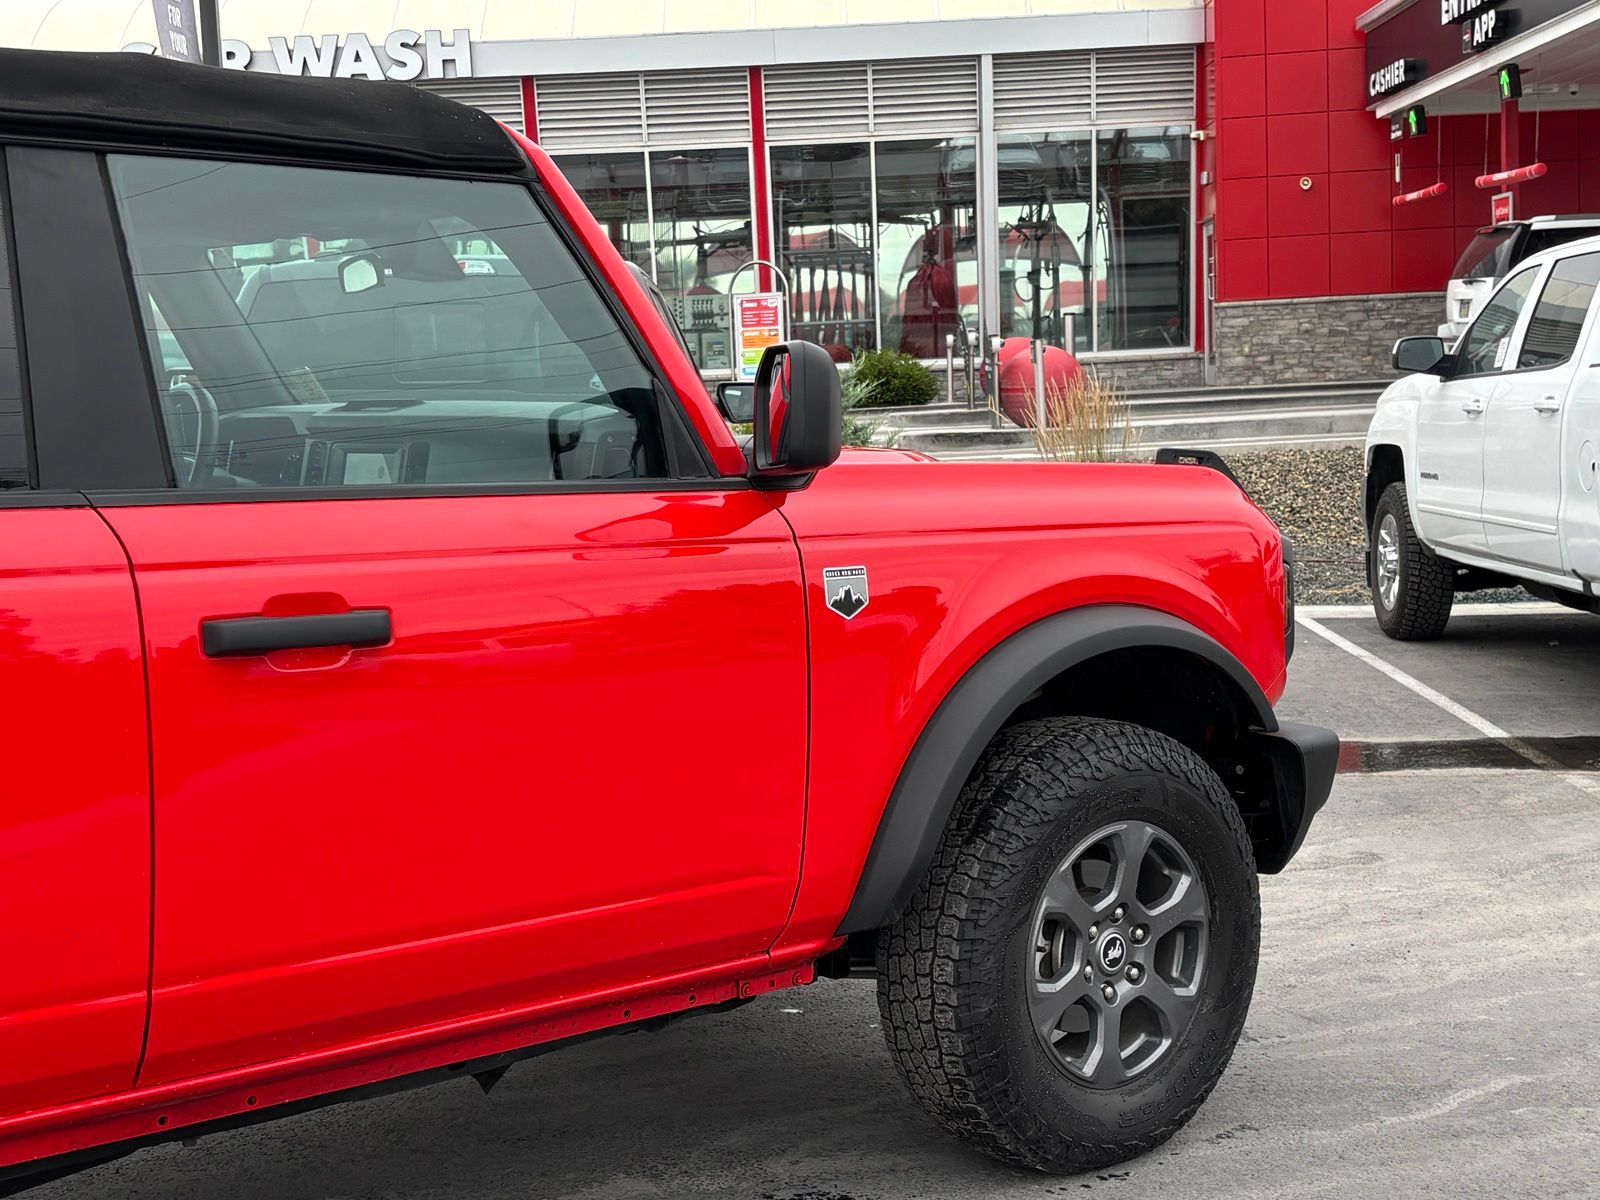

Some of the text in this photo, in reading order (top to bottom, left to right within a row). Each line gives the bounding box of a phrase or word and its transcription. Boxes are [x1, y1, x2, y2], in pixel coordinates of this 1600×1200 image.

[167, 4, 182, 28] FOR
[1473, 9, 1496, 46] APP
[169, 30, 189, 57] YOUR
[268, 28, 474, 81] WASH
[1370, 58, 1405, 97] CASHIER
